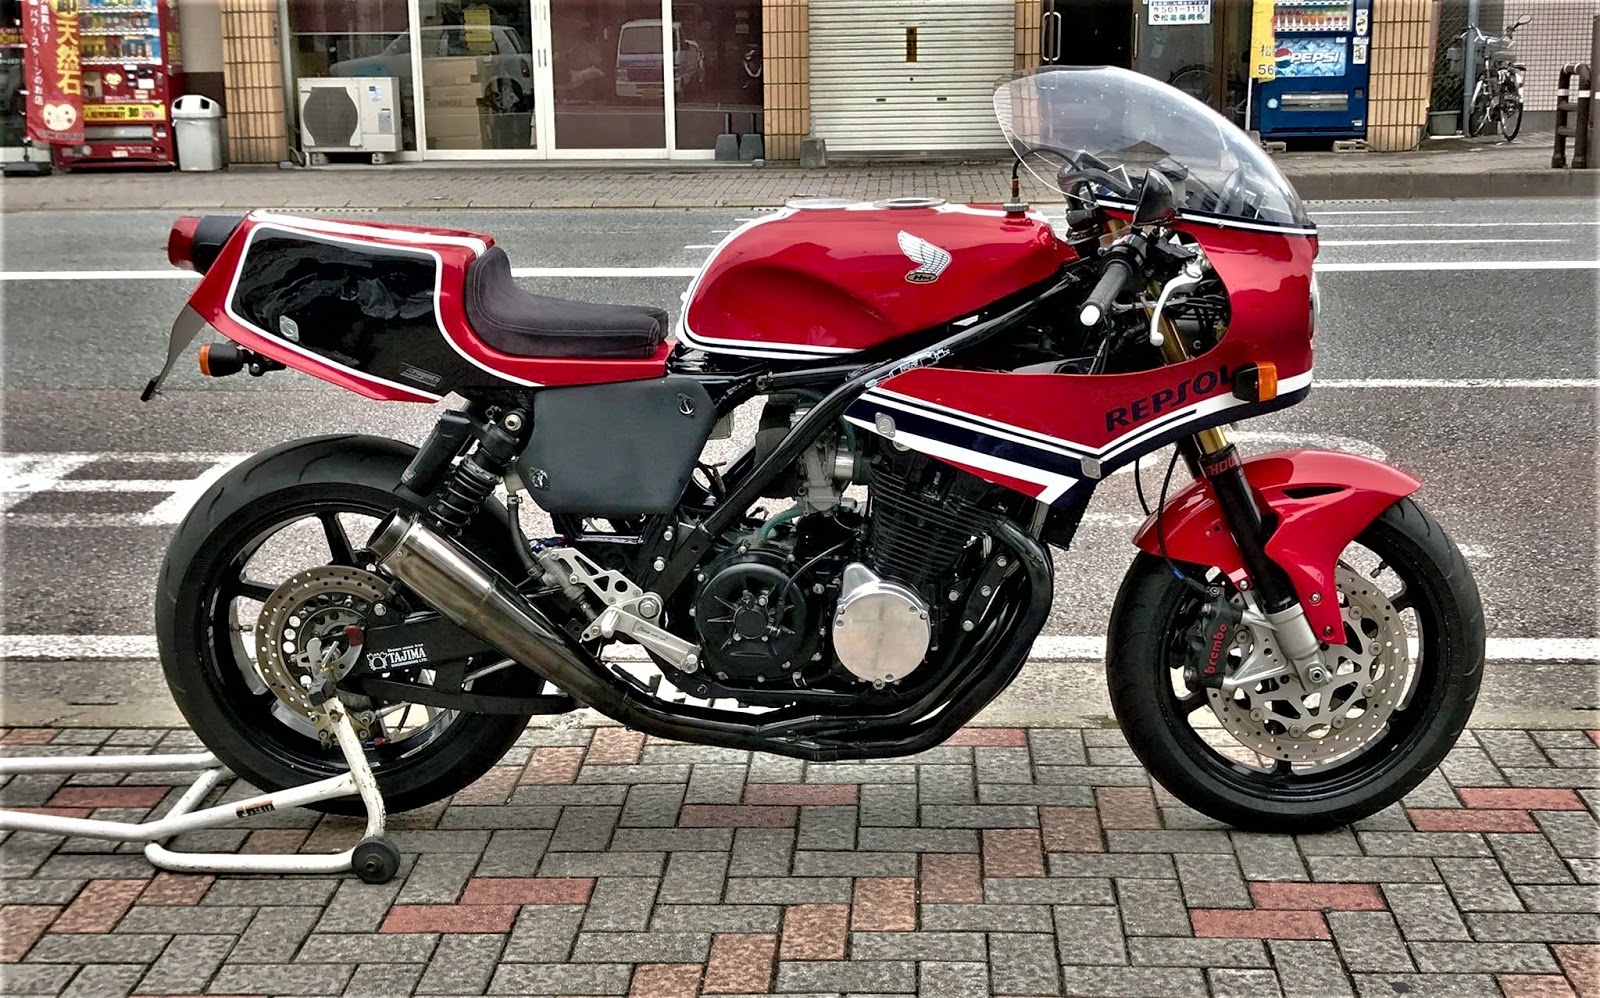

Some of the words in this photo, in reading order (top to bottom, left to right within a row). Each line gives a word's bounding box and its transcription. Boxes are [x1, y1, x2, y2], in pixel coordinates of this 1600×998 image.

[1290, 52, 1340, 63] PEPSI
[1105, 365, 1233, 432] REPSOL
[387, 647, 426, 663] TAJIMA
[1204, 624, 1227, 675] brembo
